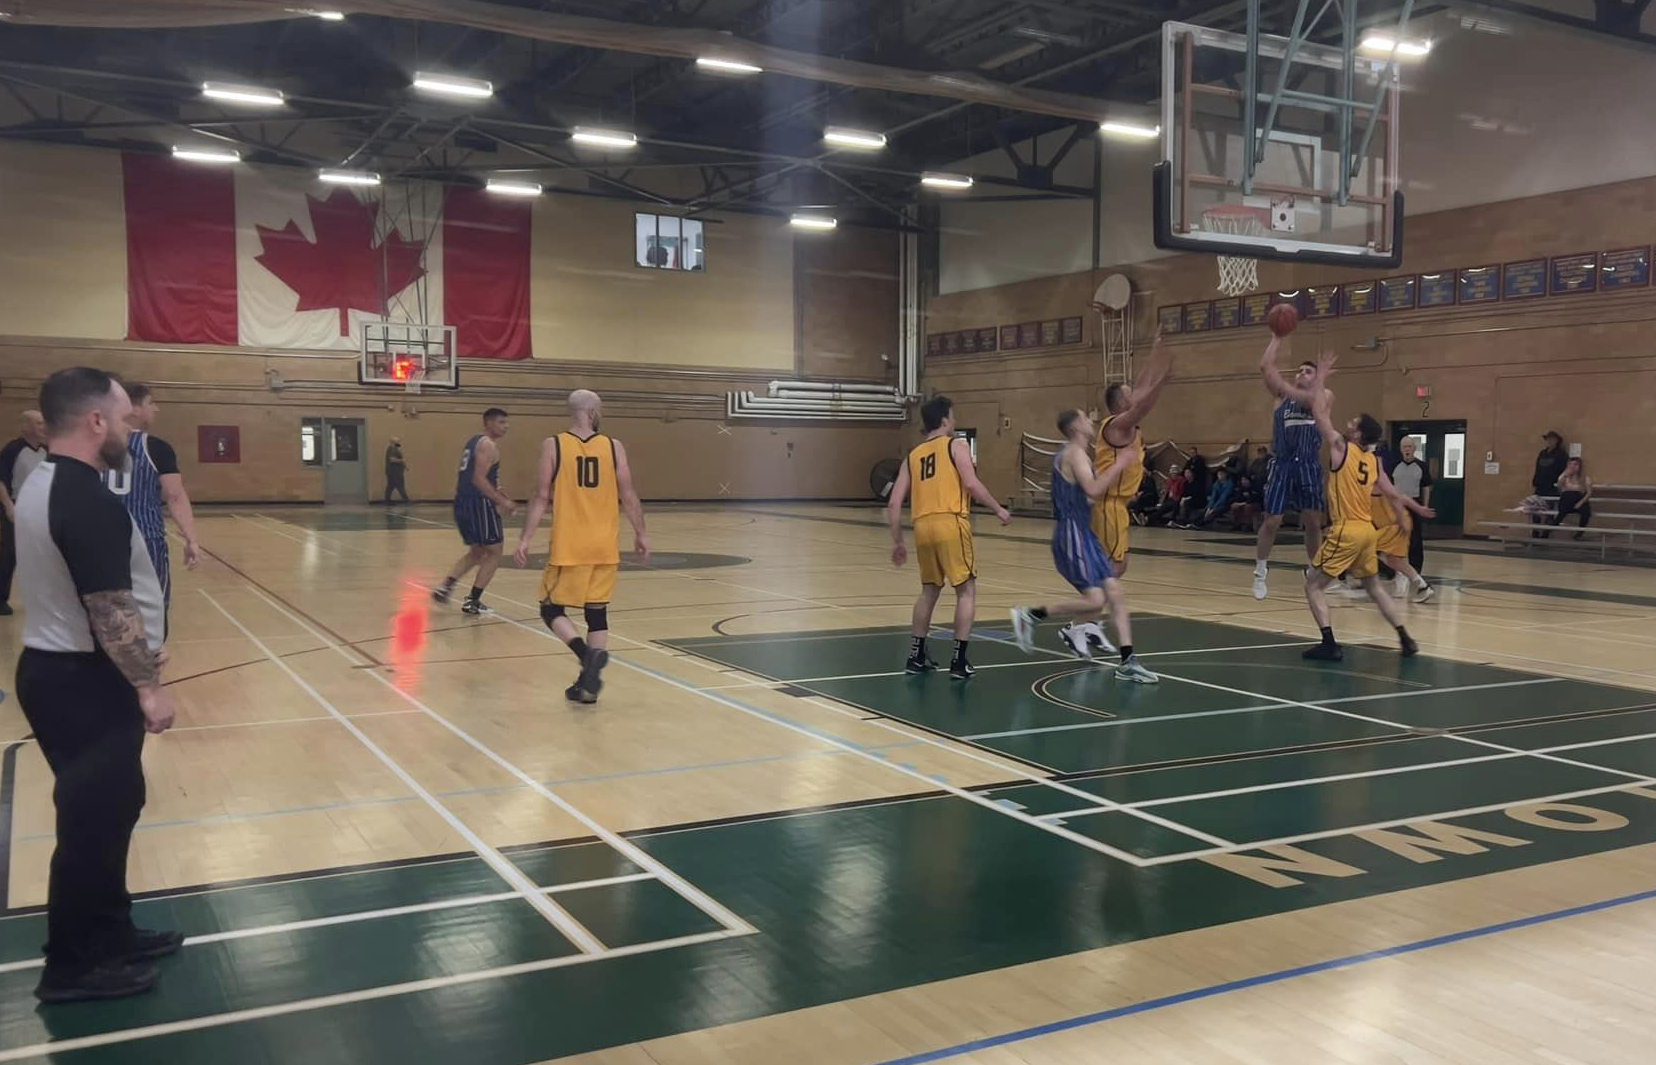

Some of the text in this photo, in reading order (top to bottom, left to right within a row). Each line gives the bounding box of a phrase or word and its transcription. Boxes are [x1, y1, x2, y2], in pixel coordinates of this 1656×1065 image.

[1422, 401, 1430, 418] 2
[576, 455, 599, 488] 10
[920, 452, 936, 481] 18
[1357, 461, 1369, 485] 5
